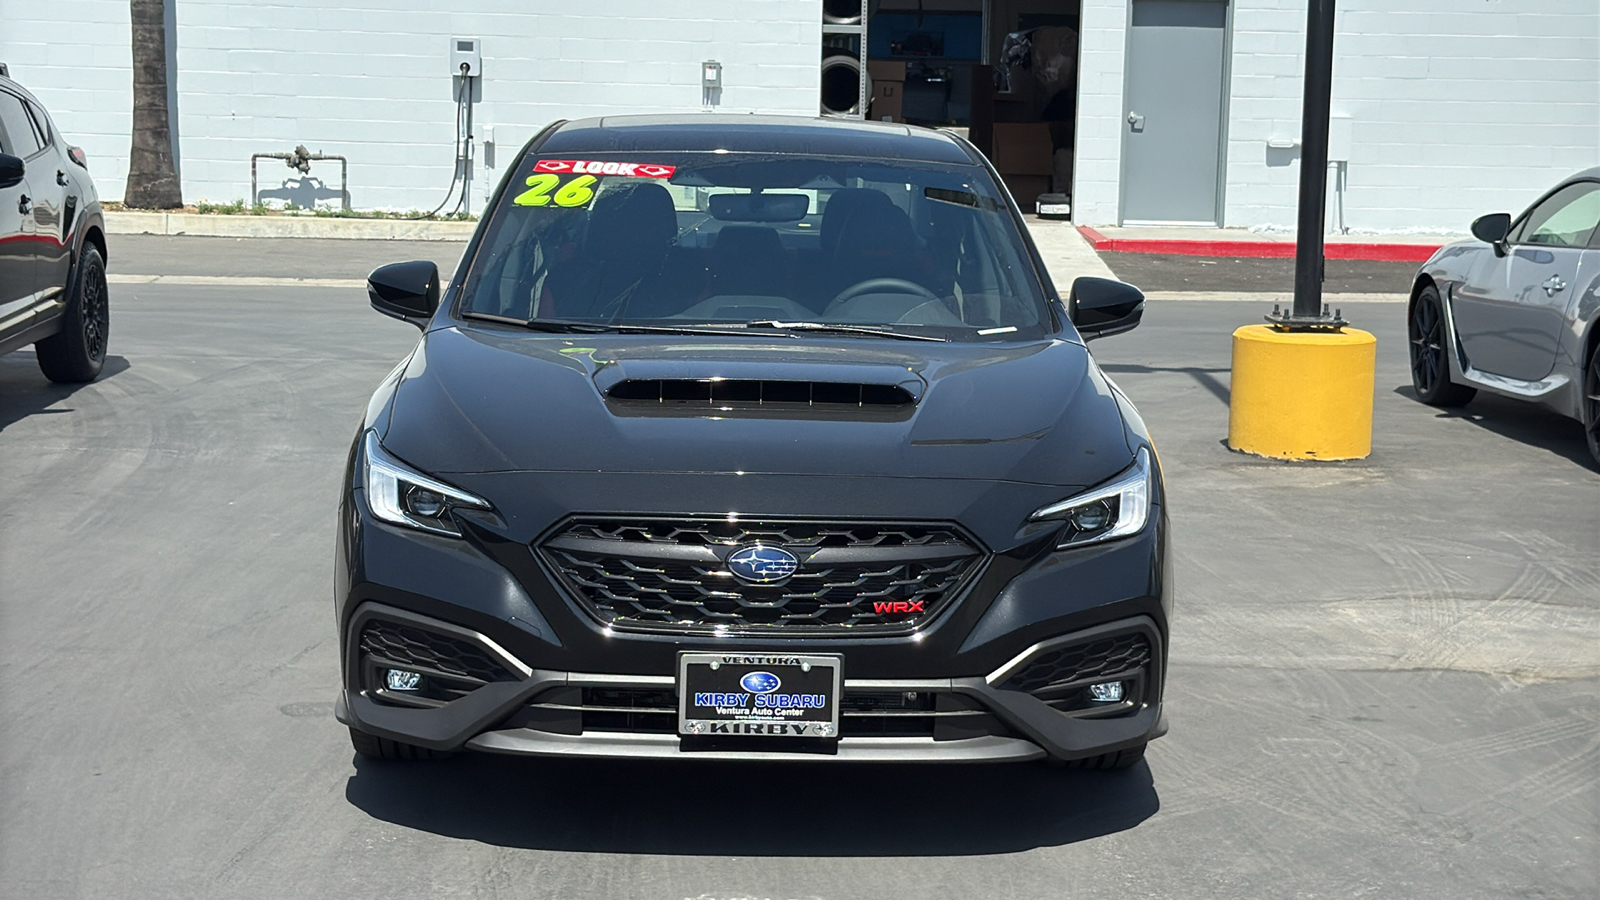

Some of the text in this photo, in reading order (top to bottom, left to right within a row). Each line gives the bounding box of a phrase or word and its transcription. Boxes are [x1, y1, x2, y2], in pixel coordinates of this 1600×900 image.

[572, 161, 638, 175] LOOK
[513, 174, 598, 207] 26
[873, 600, 924, 613] WRX
[722, 656, 801, 665] VENTURA
[695, 693, 826, 709] KIRBY SUBARU
[716, 706, 804, 716] Ventura Auto Center
[710, 723, 809, 735] KIRBY
